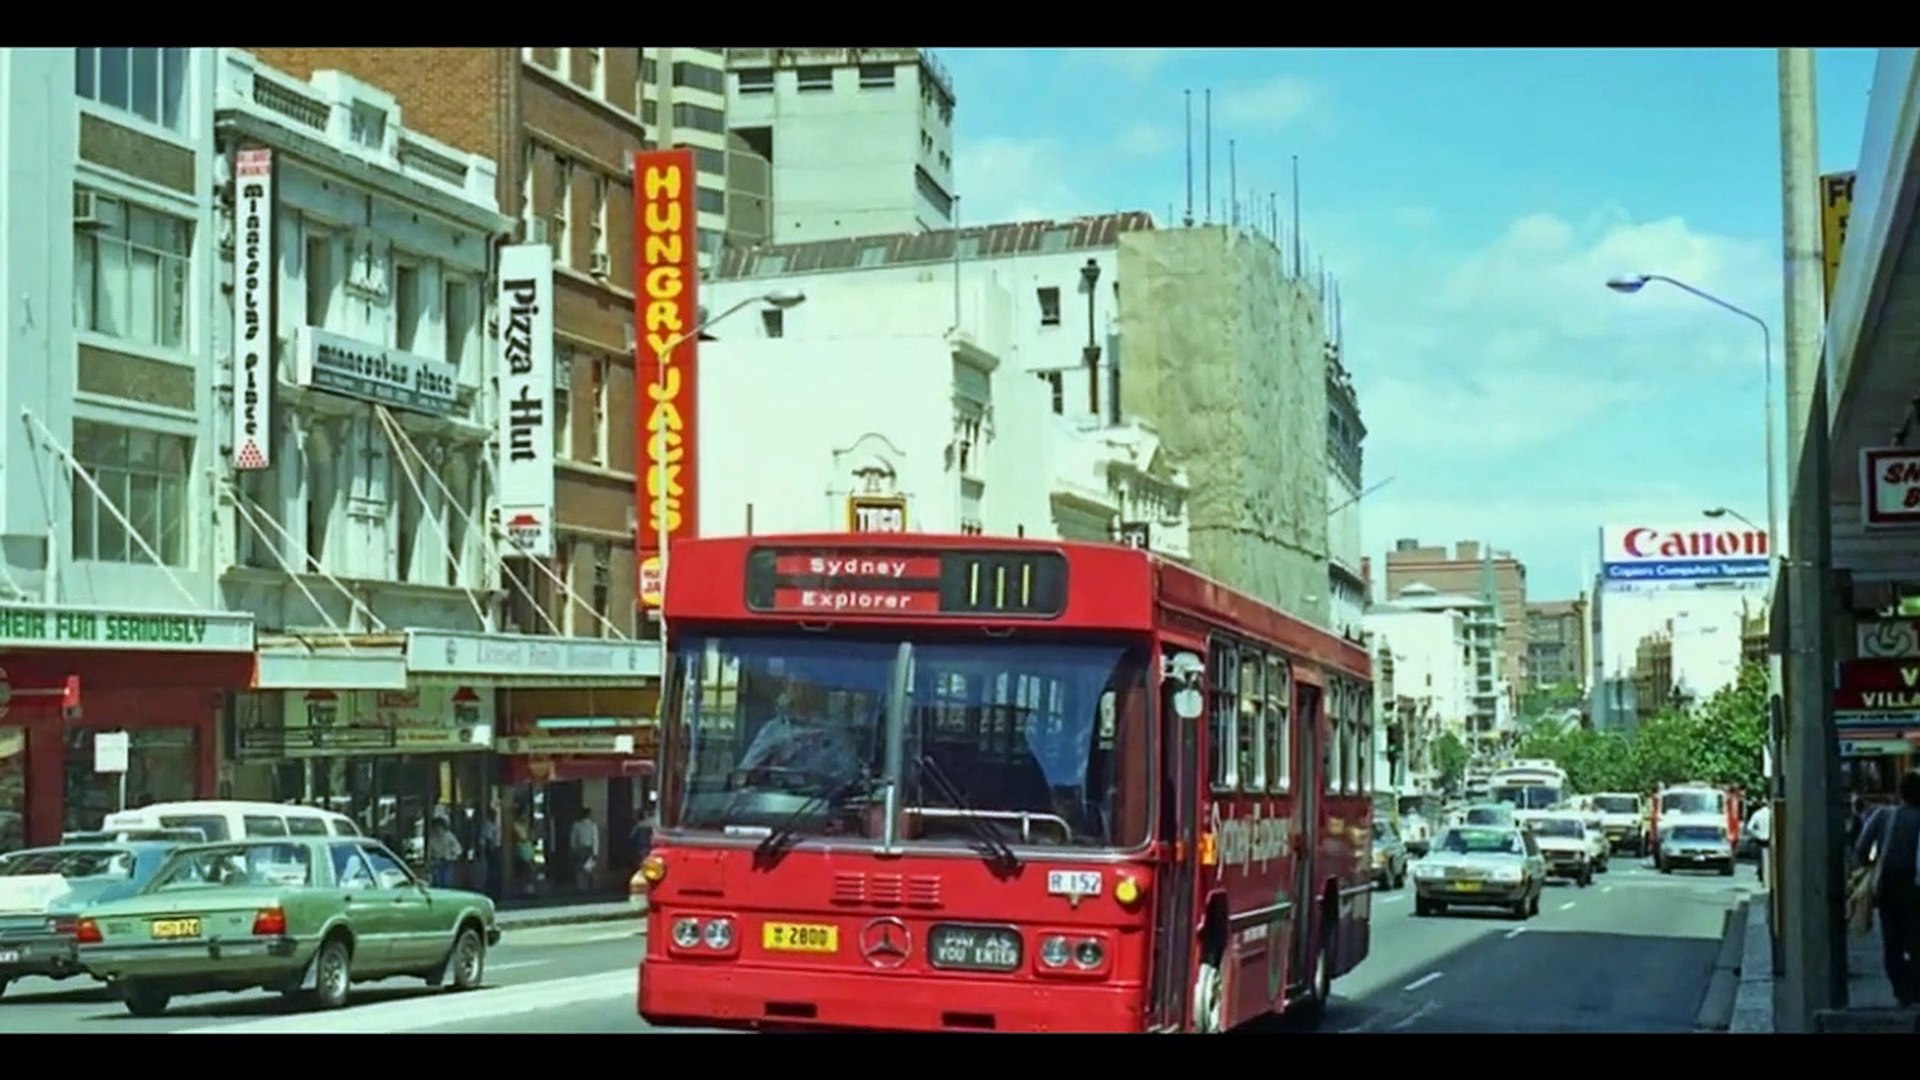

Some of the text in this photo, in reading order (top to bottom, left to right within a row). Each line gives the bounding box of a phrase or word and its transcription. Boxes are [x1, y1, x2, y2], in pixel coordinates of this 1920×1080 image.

[645, 165, 683, 532] HUNGRY JACKS
[503, 279, 543, 462] Pizza Hut
[1623, 527, 1768, 558] Canon
[810, 557, 907, 578] Sydney
[801, 591, 911, 610] Explorer
[106, 616, 206, 644] SERIOUSLY
[1070, 873, 1100, 892] 152
[789, 926, 829, 946] 2800
[938, 946, 1018, 966] YOU ENTER
